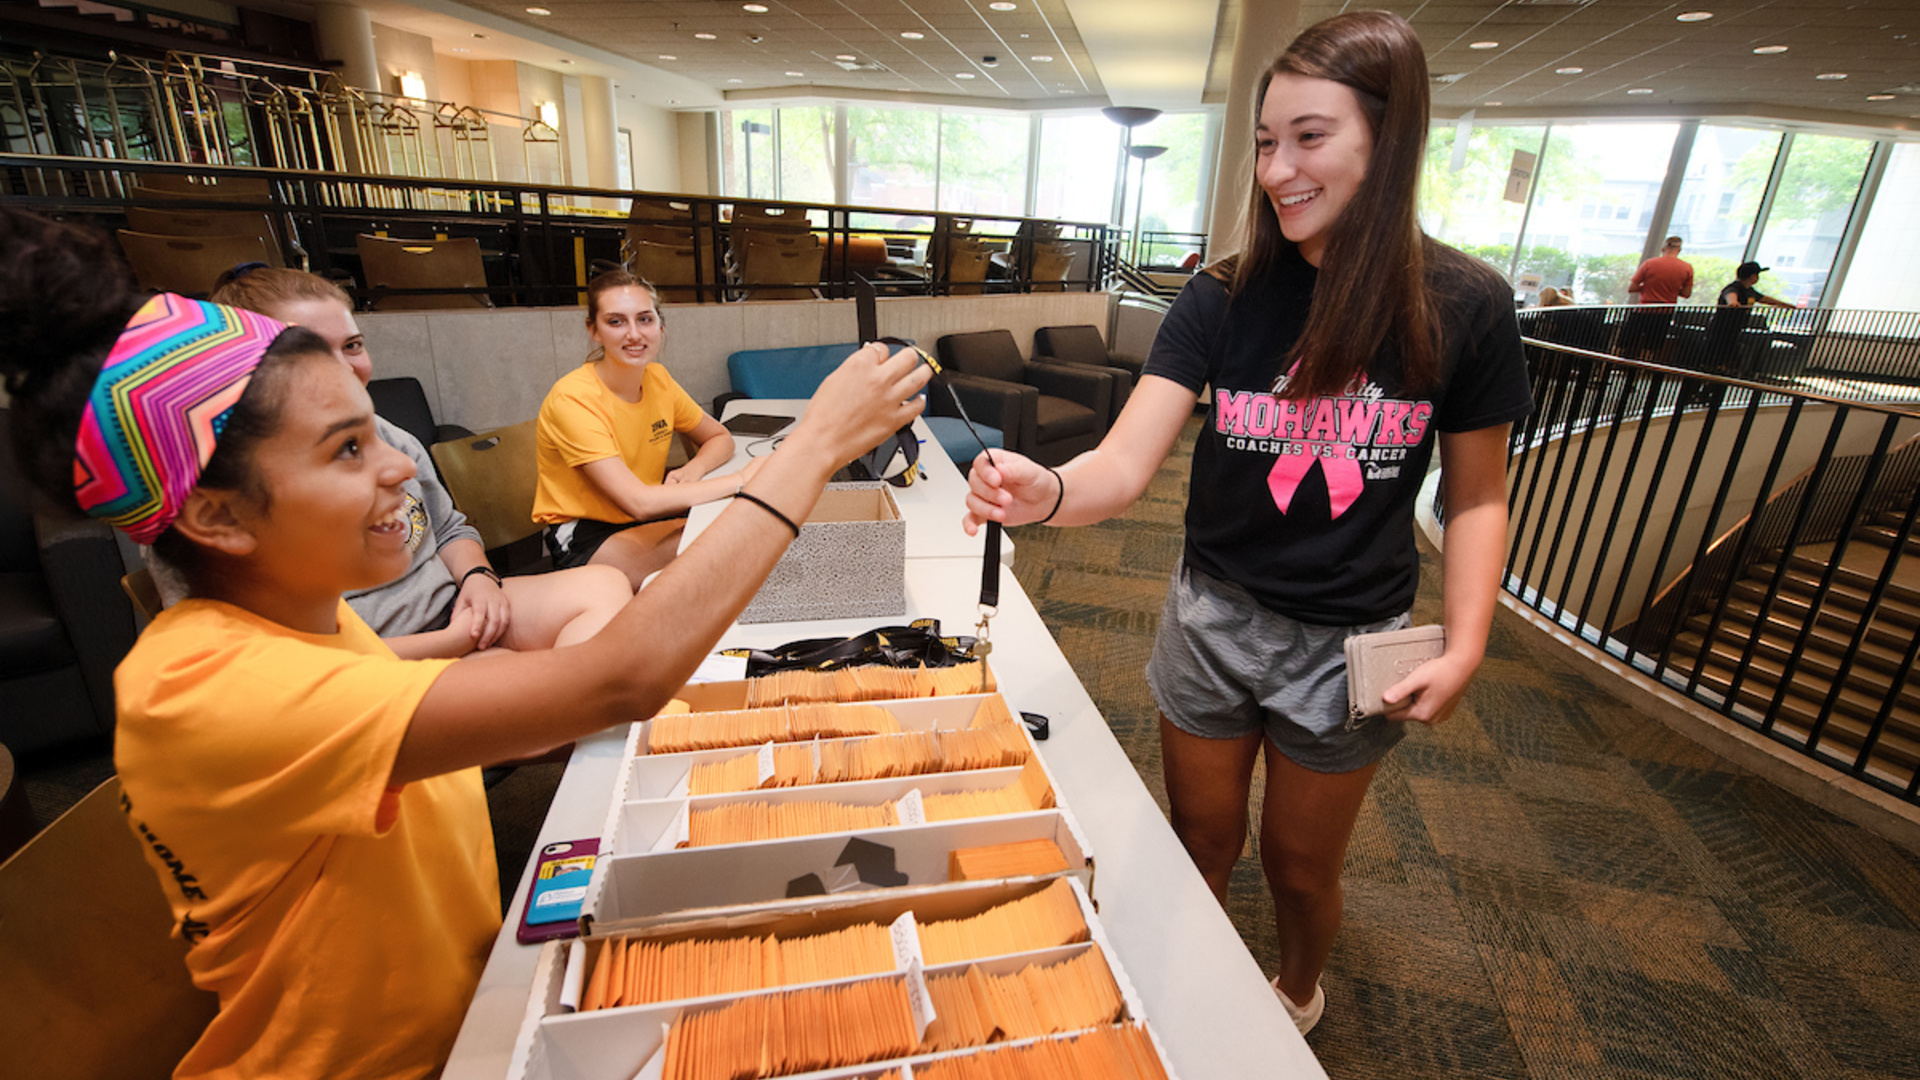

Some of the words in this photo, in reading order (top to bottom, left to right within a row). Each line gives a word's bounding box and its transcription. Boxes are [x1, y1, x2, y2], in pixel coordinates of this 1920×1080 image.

[1344, 379, 1384, 405] City
[1216, 388, 1433, 447] MOHAWKS
[1226, 437, 1303, 456] COACHES
[1311, 445, 1338, 458] VS.
[1345, 447, 1407, 460] CANCER
